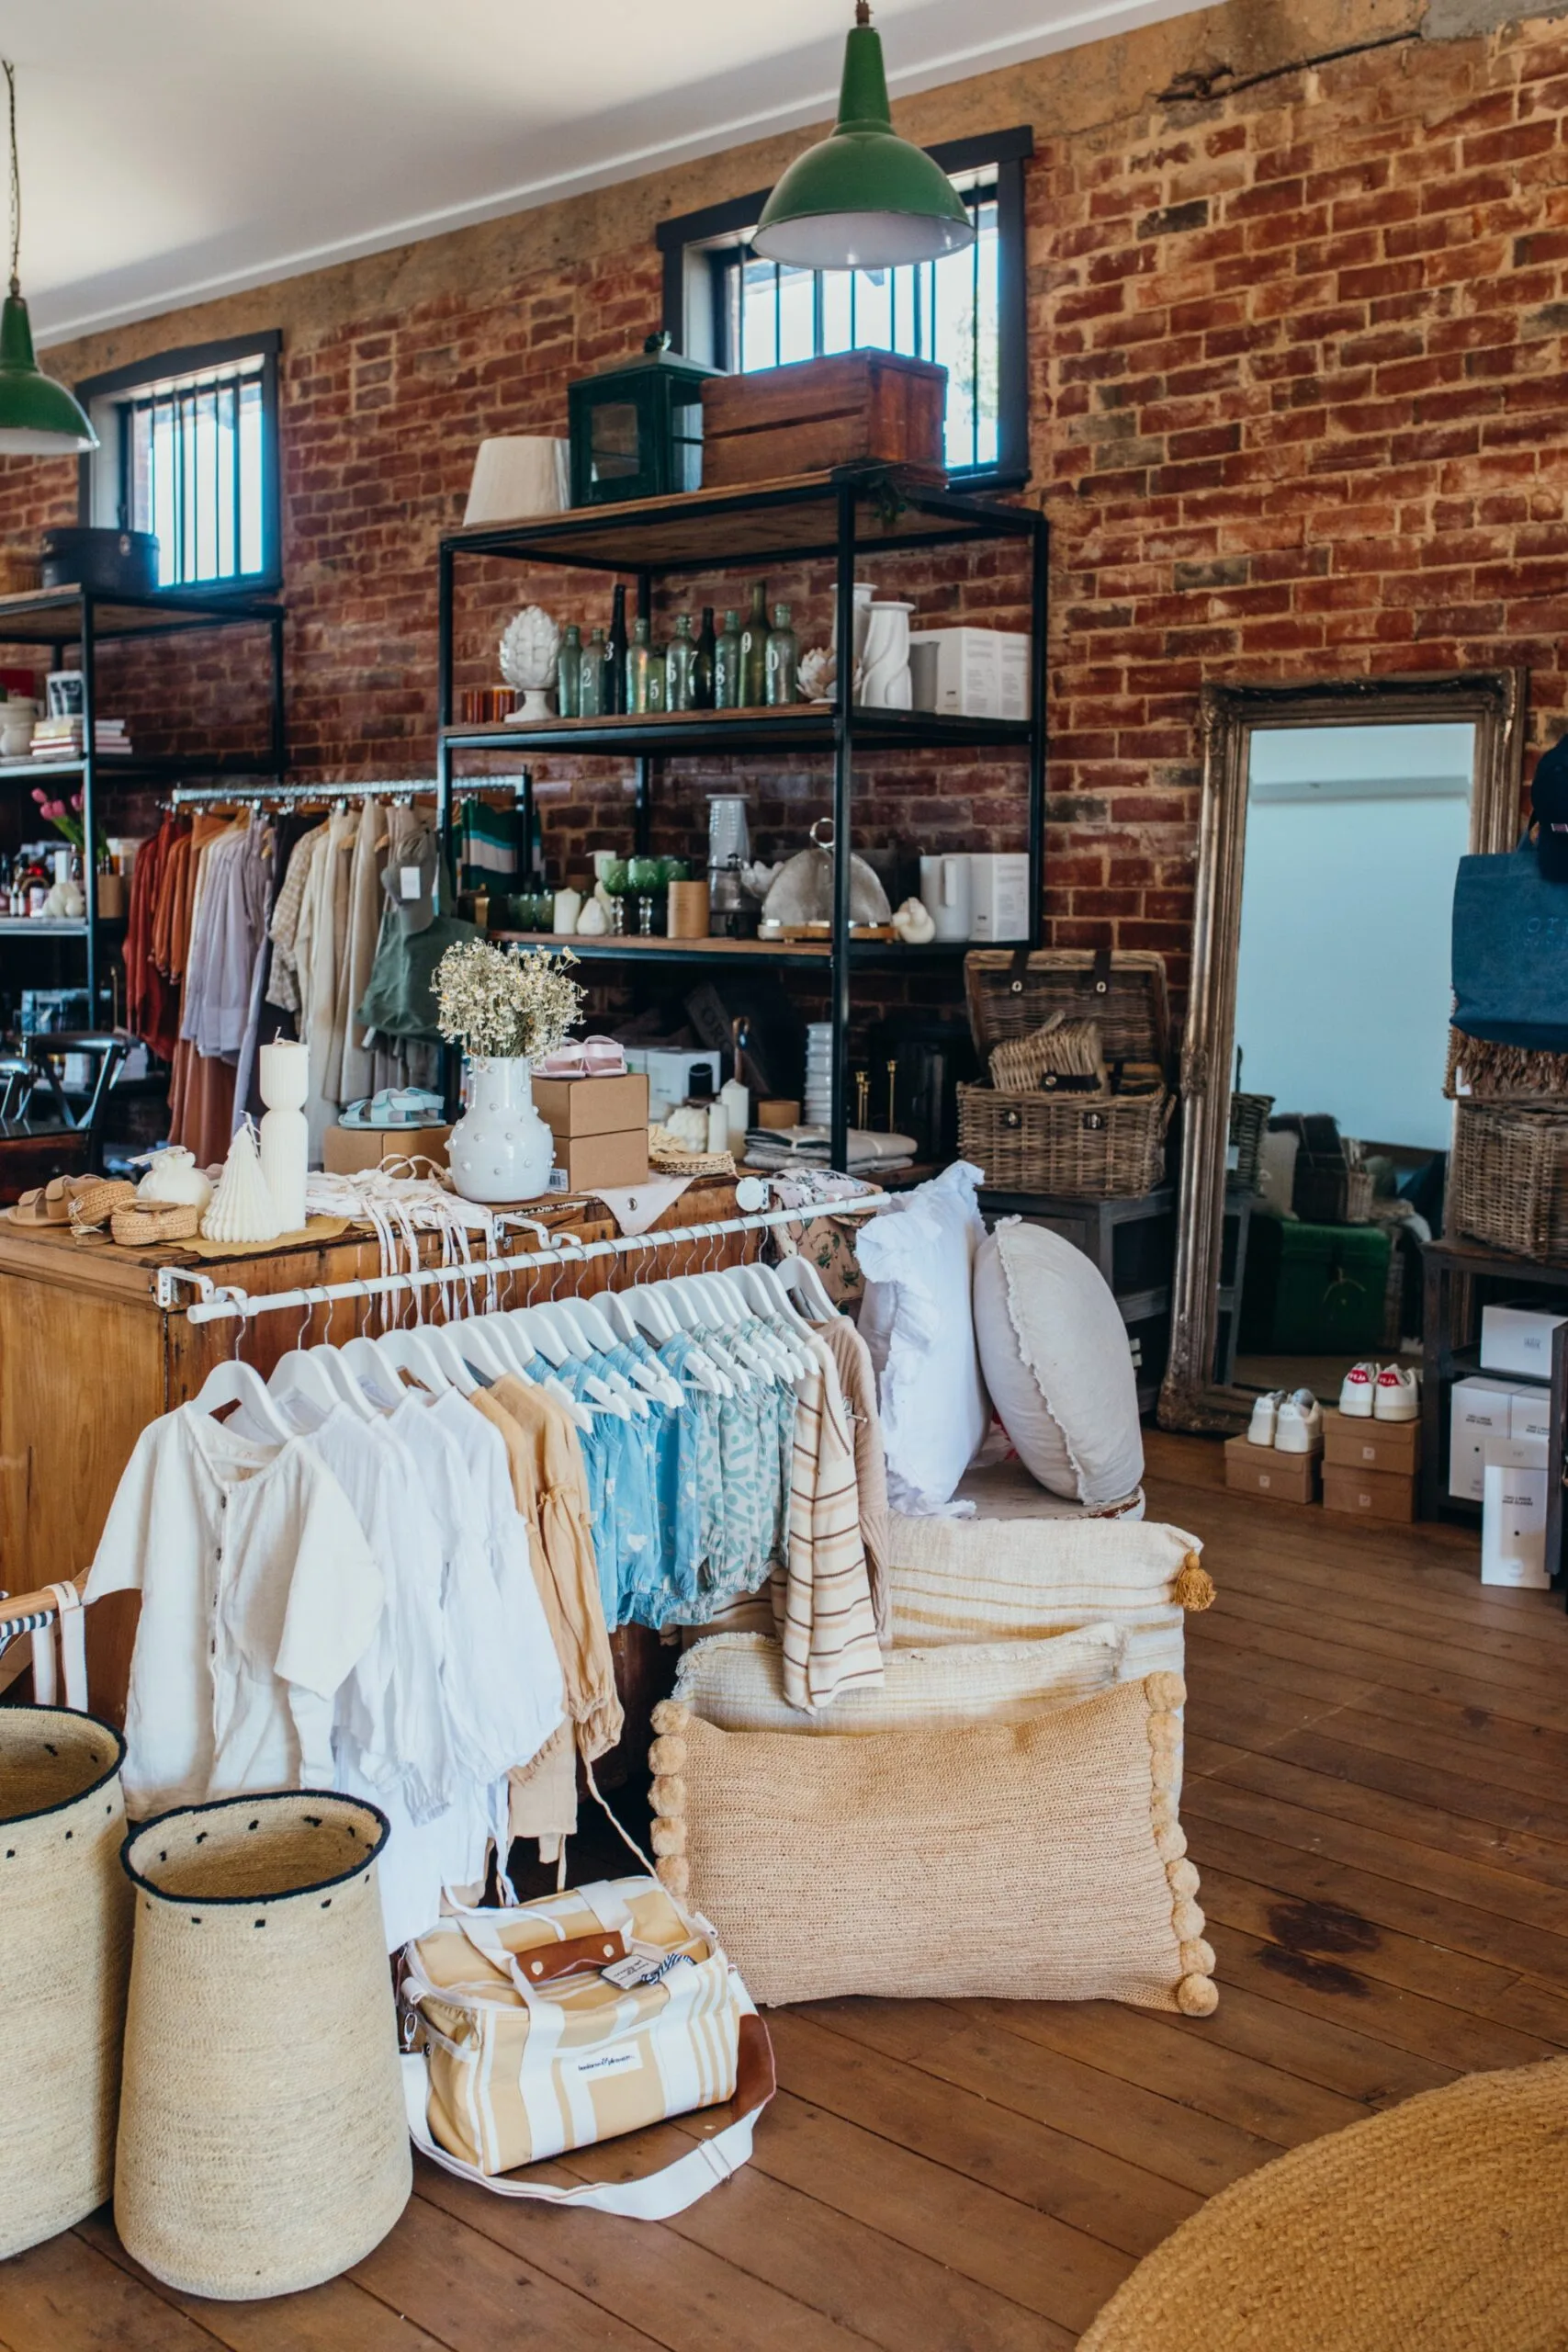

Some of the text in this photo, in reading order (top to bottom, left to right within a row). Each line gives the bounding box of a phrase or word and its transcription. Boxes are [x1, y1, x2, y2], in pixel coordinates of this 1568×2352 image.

[603, 641, 615, 662] 3
[740, 631, 752, 653] 9
[666, 661, 677, 683] 6
[688, 650, 699, 672] 7
[582, 667, 592, 687] 2
[715, 663, 726, 685] 8
[649, 678, 660, 699] 5
